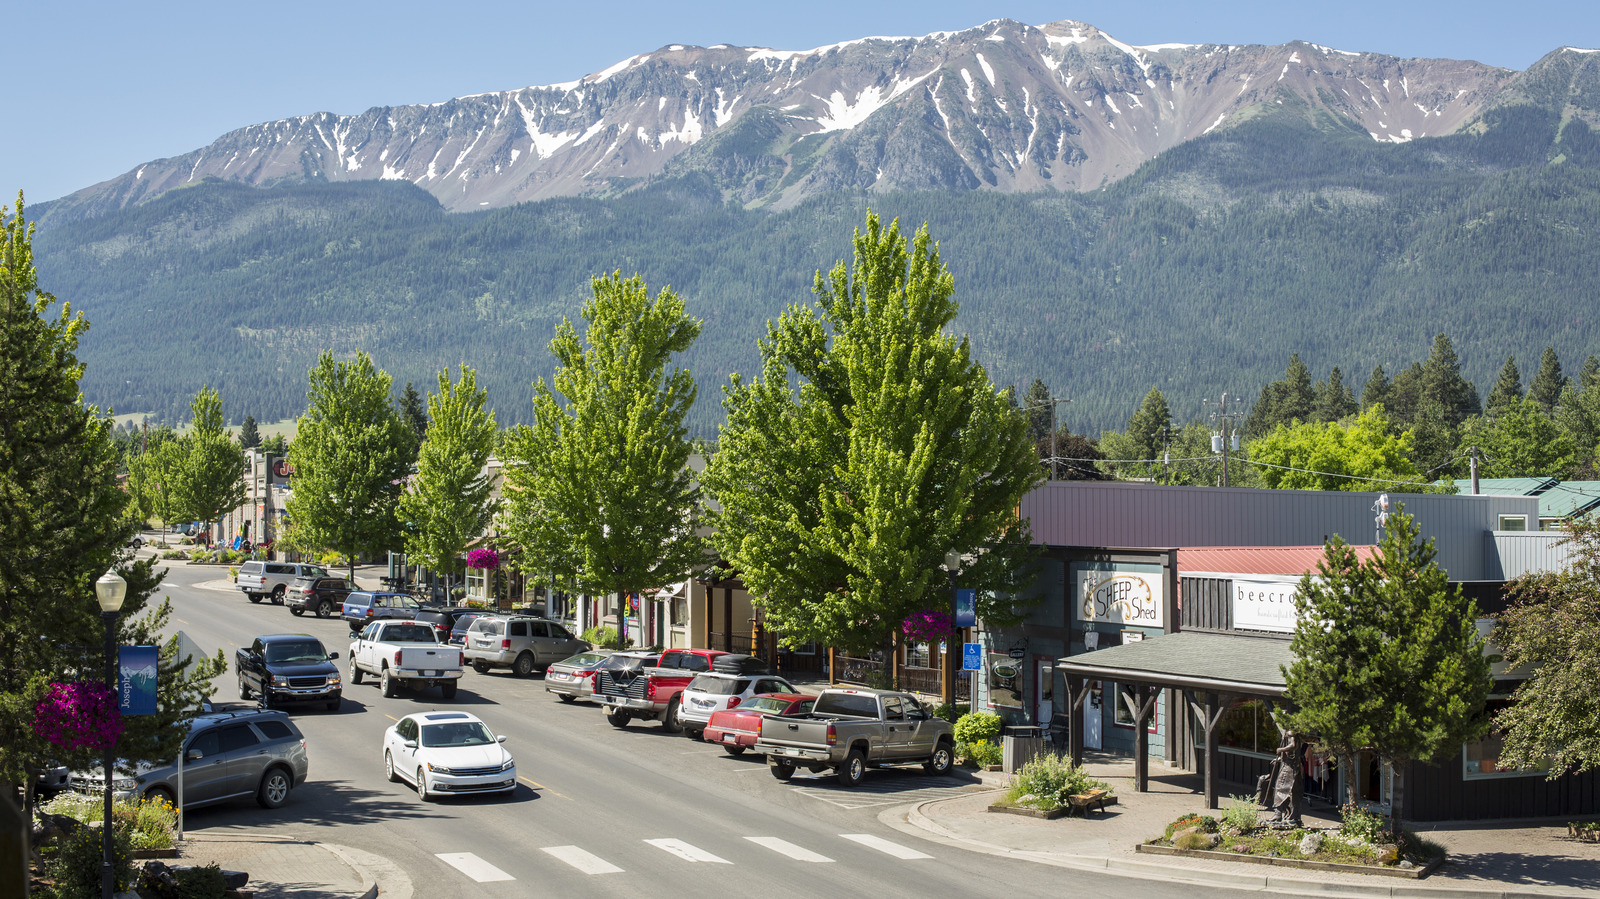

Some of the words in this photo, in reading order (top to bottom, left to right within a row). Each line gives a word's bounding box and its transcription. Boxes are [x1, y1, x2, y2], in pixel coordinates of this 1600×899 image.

[1096, 581, 1132, 618] SHEEP
[1131, 596, 1157, 621] Shed
[1238, 586, 1296, 604] beecro
[121, 676, 133, 709] Joseph
